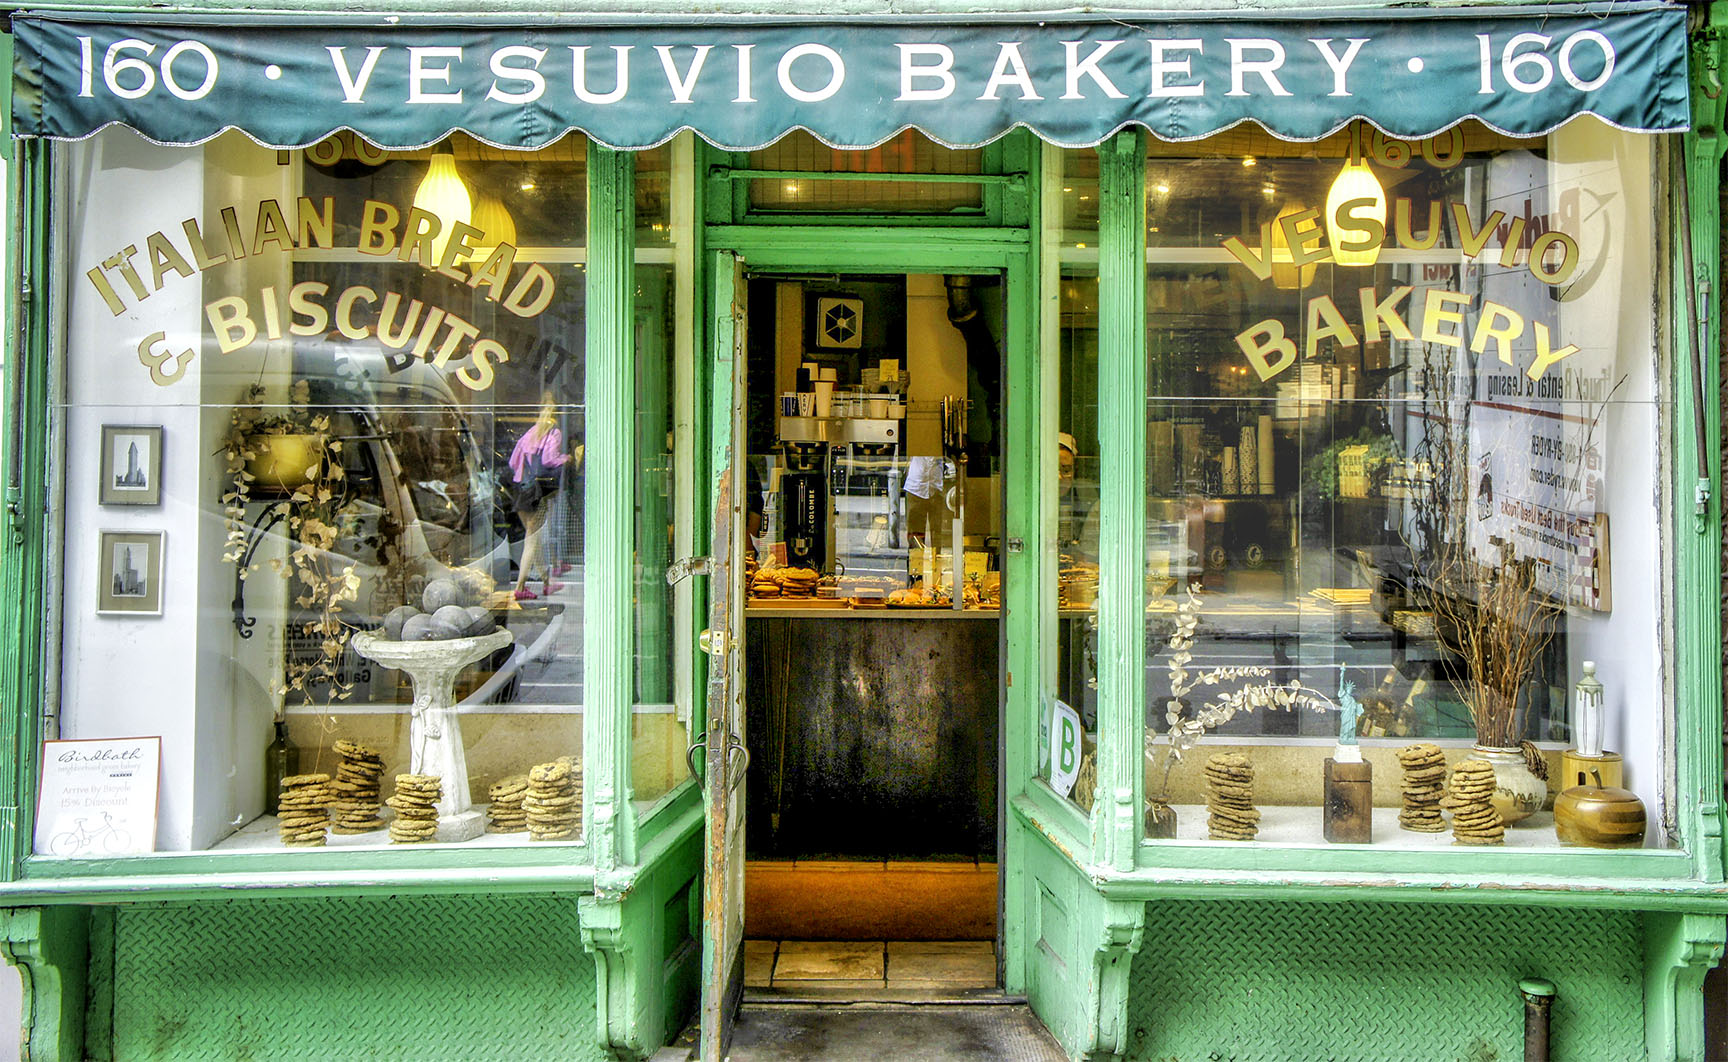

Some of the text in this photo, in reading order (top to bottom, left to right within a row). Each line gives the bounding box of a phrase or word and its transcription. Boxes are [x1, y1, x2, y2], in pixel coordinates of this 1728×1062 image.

[77, 30, 1616, 109] 160 VESUVIO BAKERY 160
[1347, 118, 1465, 169] 160
[86, 196, 556, 318] ITALIAN BREAD
[1221, 198, 1580, 285] VESUVIO
[137, 281, 510, 391] & BISCUITS
[1234, 285, 1581, 382] BAKERY
[58, 748, 141, 763] Birdbath
[1060, 716, 1074, 774] B
